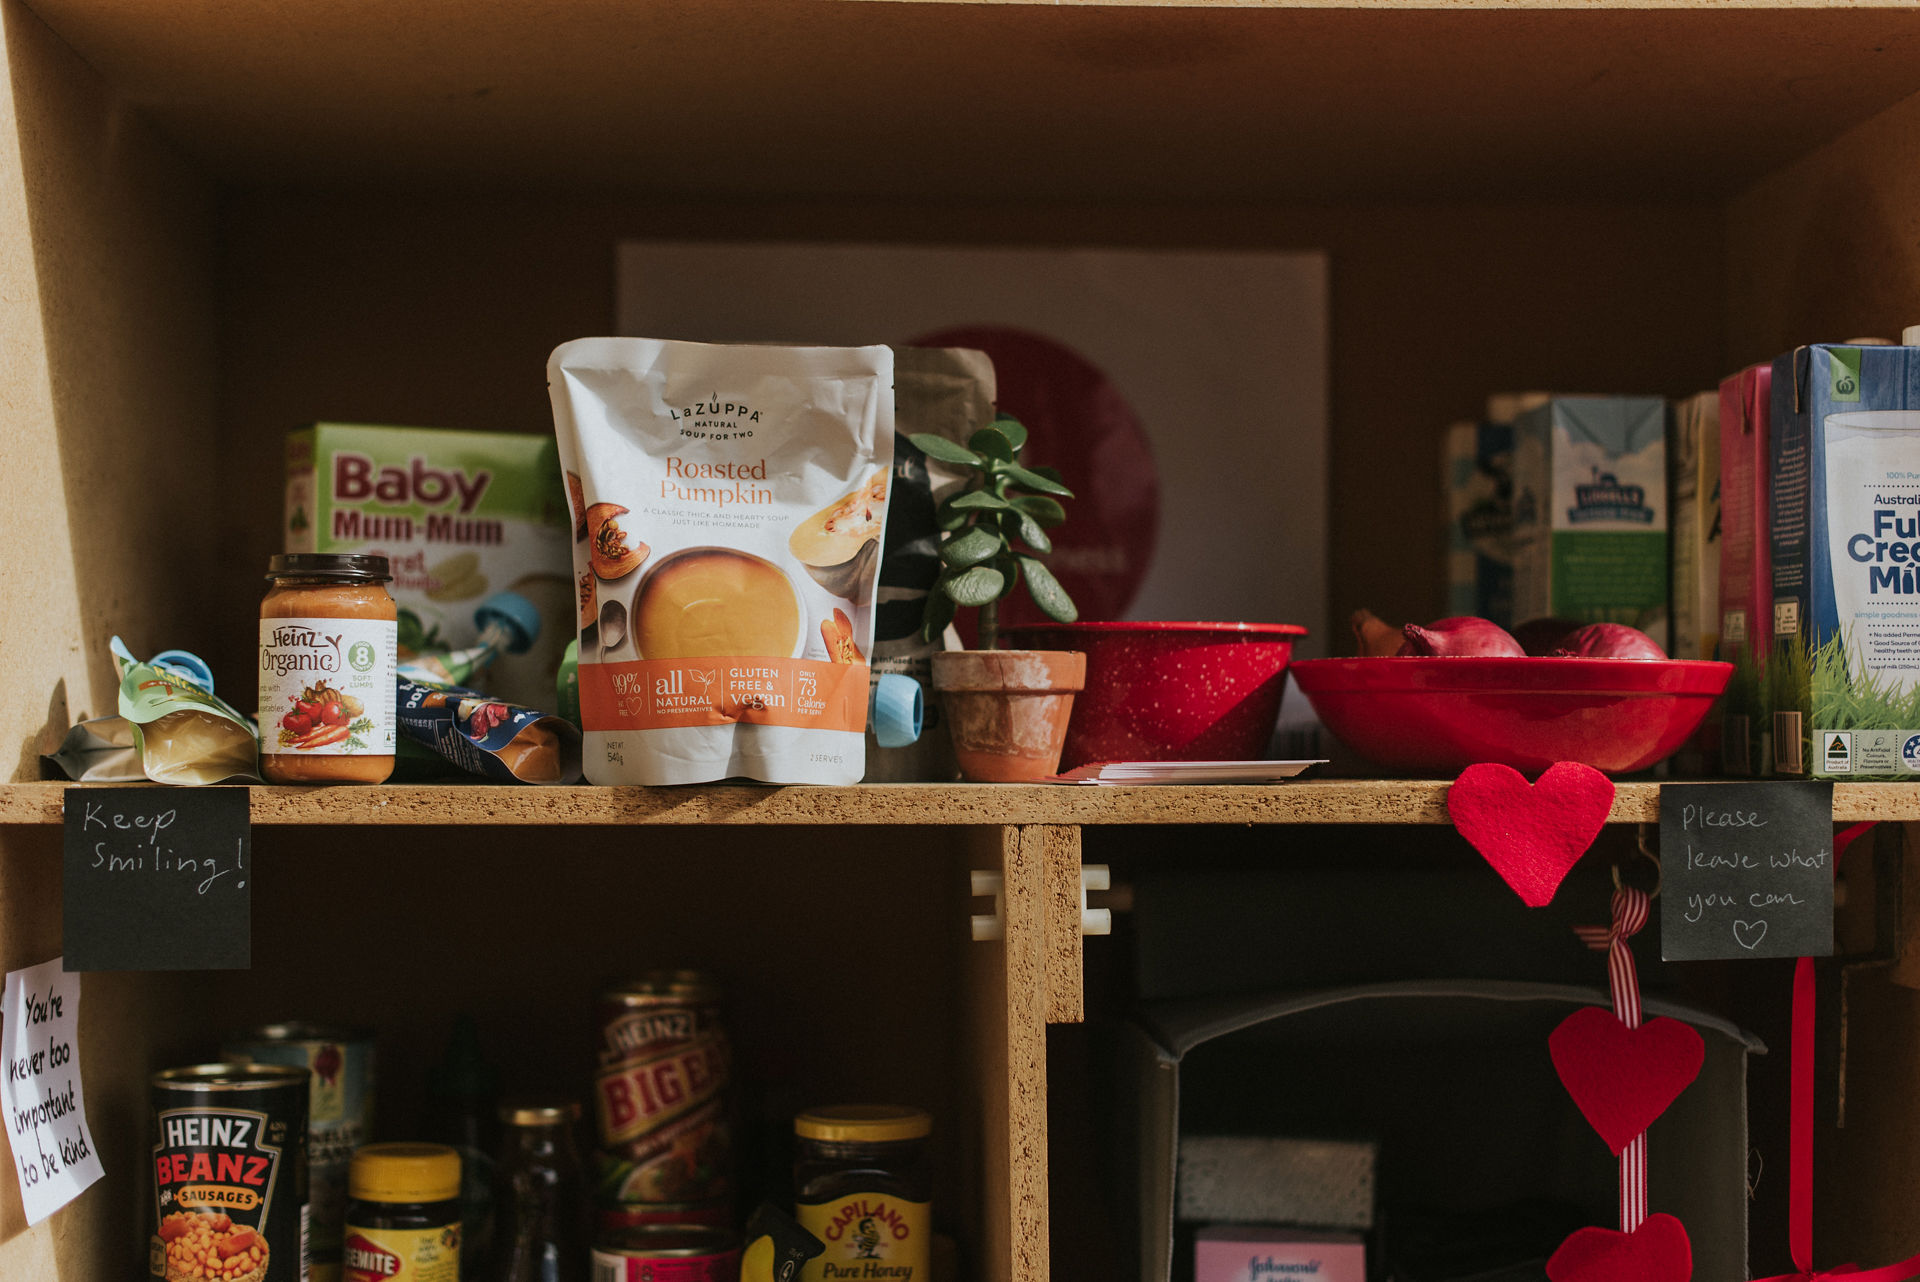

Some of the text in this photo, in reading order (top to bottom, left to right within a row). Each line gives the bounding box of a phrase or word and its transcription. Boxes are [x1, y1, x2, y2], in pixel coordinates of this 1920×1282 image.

[670, 402, 760, 423] LaZUPPA
[680, 429, 754, 441] SOUP FOR TWO
[695, 420, 738, 429] NATURAL
[666, 456, 767, 481] Roasted
[1886, 471, 1906, 480] 100%
[334, 452, 492, 514] Baby
[660, 479, 772, 508] Pumpkin
[651, 508, 685, 517] CLASSIC
[687, 511, 711, 519] THICK
[713, 512, 732, 520] AND
[733, 513, 765, 521] HEARTY
[767, 514, 790, 522] SOUP
[693, 519, 710, 527] LIKE
[712, 520, 760, 529] HOMEMADE
[333, 508, 505, 545] Mum-Mum
[1854, 608, 1918, 620] simple goodness
[266, 626, 329, 648] Heinz
[262, 646, 343, 677] Organic
[356, 647, 369, 666] 8
[1873, 647, 1896, 655] healthy
[353, 674, 372, 682] SOFT
[612, 672, 641, 695] 99%
[655, 669, 683, 695] all
[729, 667, 779, 678] GLUTEN
[799, 670, 816, 678] ONLY
[349, 681, 374, 689] LUMPS
[730, 680, 774, 691] FREE &
[799, 677, 817, 697] 73
[656, 695, 713, 707] NATURAL
[667, 706, 713, 714] PRESERVATIVES
[730, 692, 785, 710] vegan
[810, 753, 844, 764] 2 SERVES
[84, 802, 176, 844] Keep
[1683, 803, 1768, 830] Please
[92, 838, 246, 894] Smiling!
[1688, 845, 1829, 870] leave what
[1684, 893, 1804, 922] you can
[25, 985, 63, 1028] You're
[613, 1015, 688, 1050] HEINZ
[10, 1036, 70, 1083] never too
[603, 1059, 685, 1129] BIG
[13, 1079, 76, 1135] important
[167, 1117, 252, 1148] HEINZ
[20, 1125, 91, 1187] to be kind
[156, 1152, 270, 1186] BEANZ
[181, 1190, 253, 1204] SAUSAGES
[825, 1200, 910, 1241] CAPILANO
[823, 1261, 913, 1282] Pure Honey
